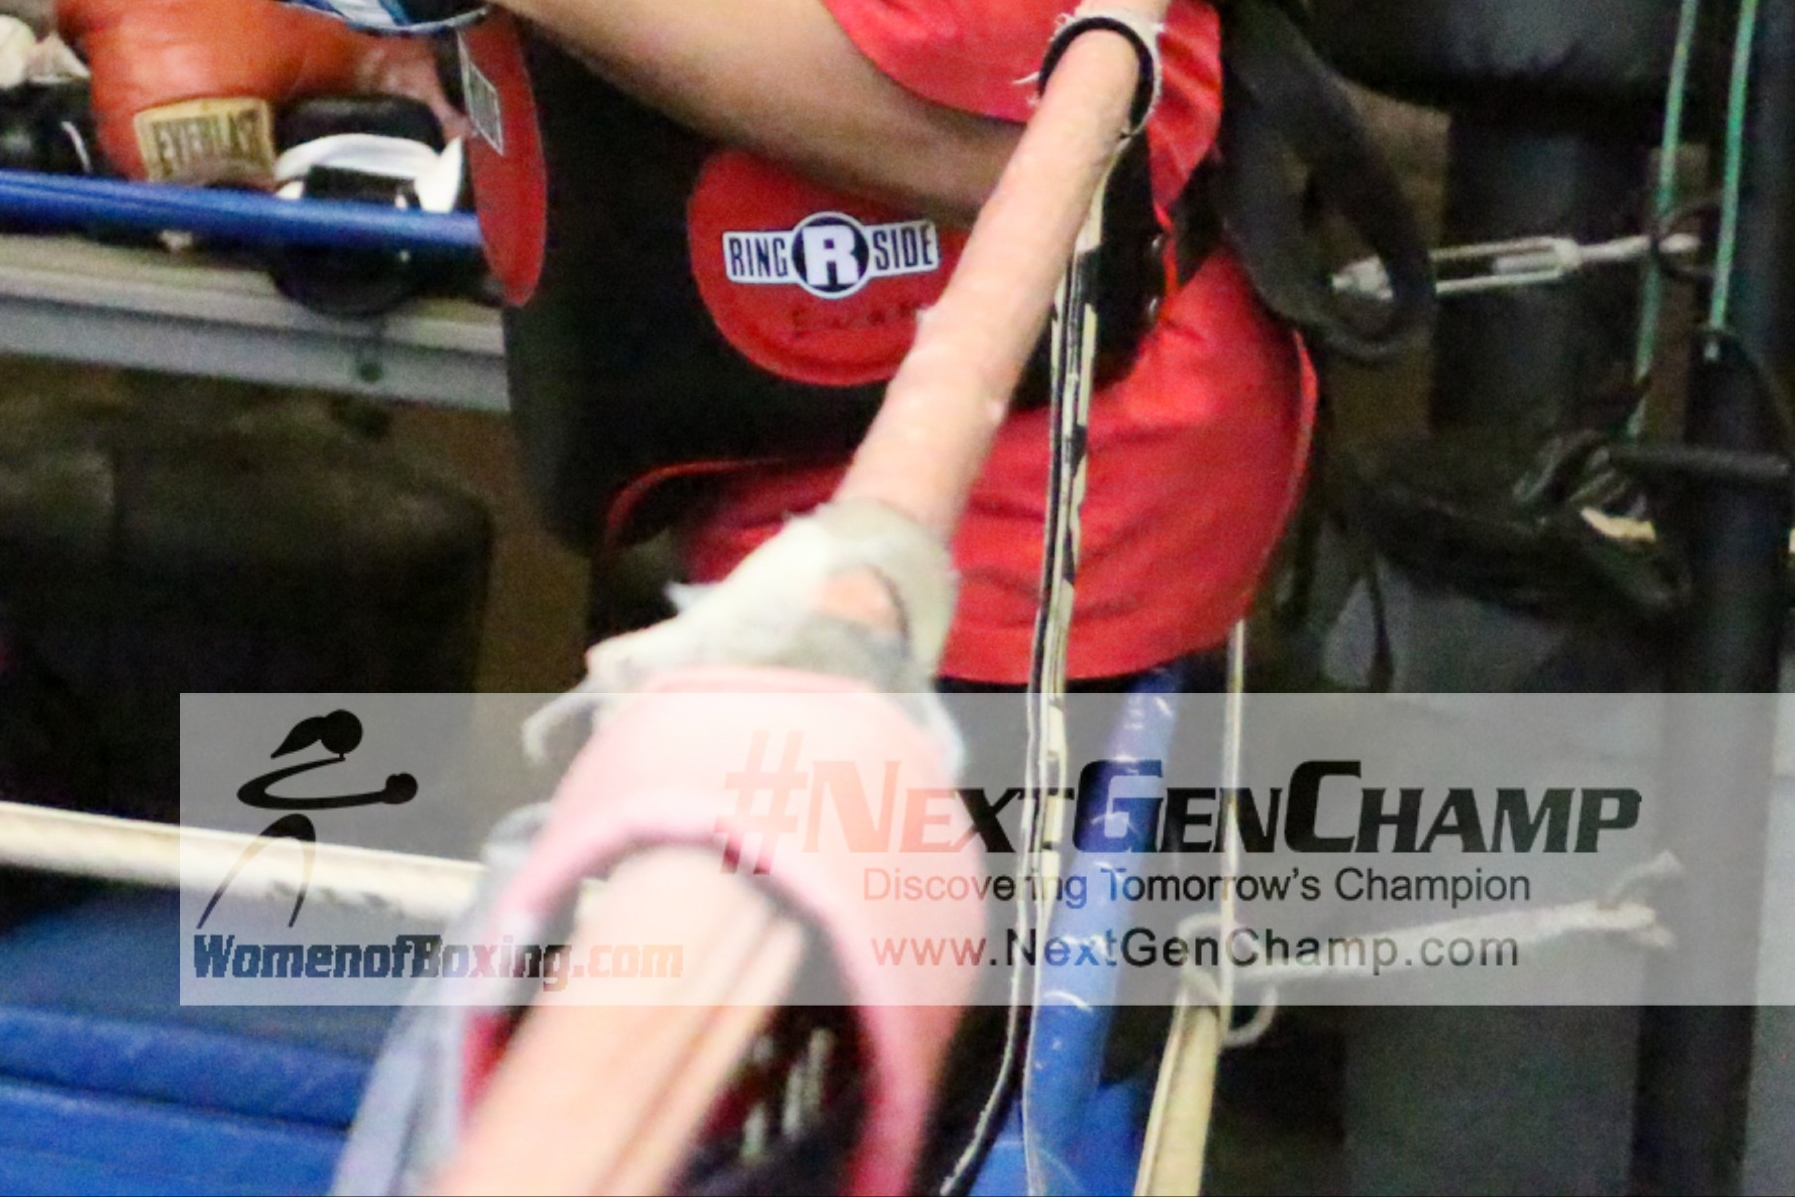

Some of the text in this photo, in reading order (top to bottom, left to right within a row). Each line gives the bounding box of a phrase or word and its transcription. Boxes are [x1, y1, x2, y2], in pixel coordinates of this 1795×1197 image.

[728, 223, 934, 286] RING R SIDE
